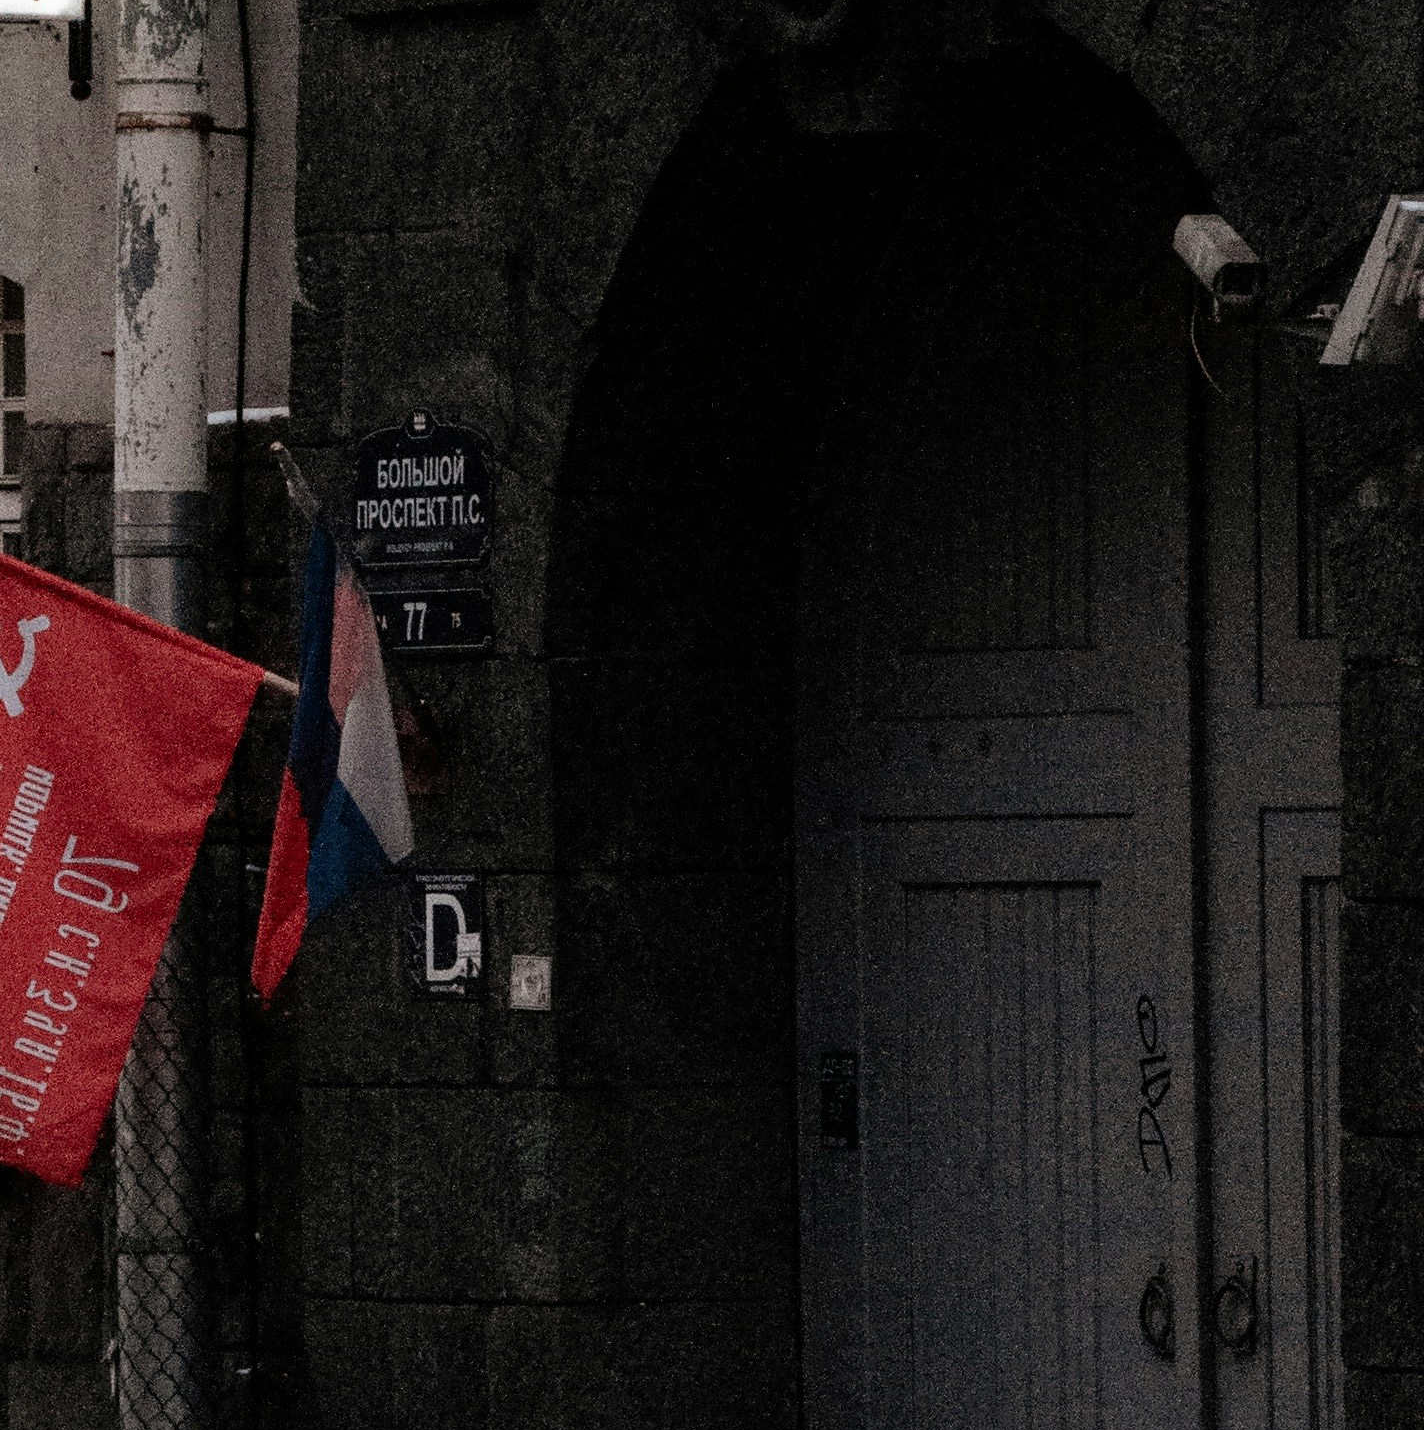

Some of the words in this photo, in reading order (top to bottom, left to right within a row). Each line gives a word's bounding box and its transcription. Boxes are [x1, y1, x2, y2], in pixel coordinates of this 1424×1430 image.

[377, 448, 465, 489] БОЛЬШОЙ
[357, 496, 447, 529] ПРОСПЕКТ
[452, 494, 485, 525] П.С.
[403, 602, 427, 641] 77
